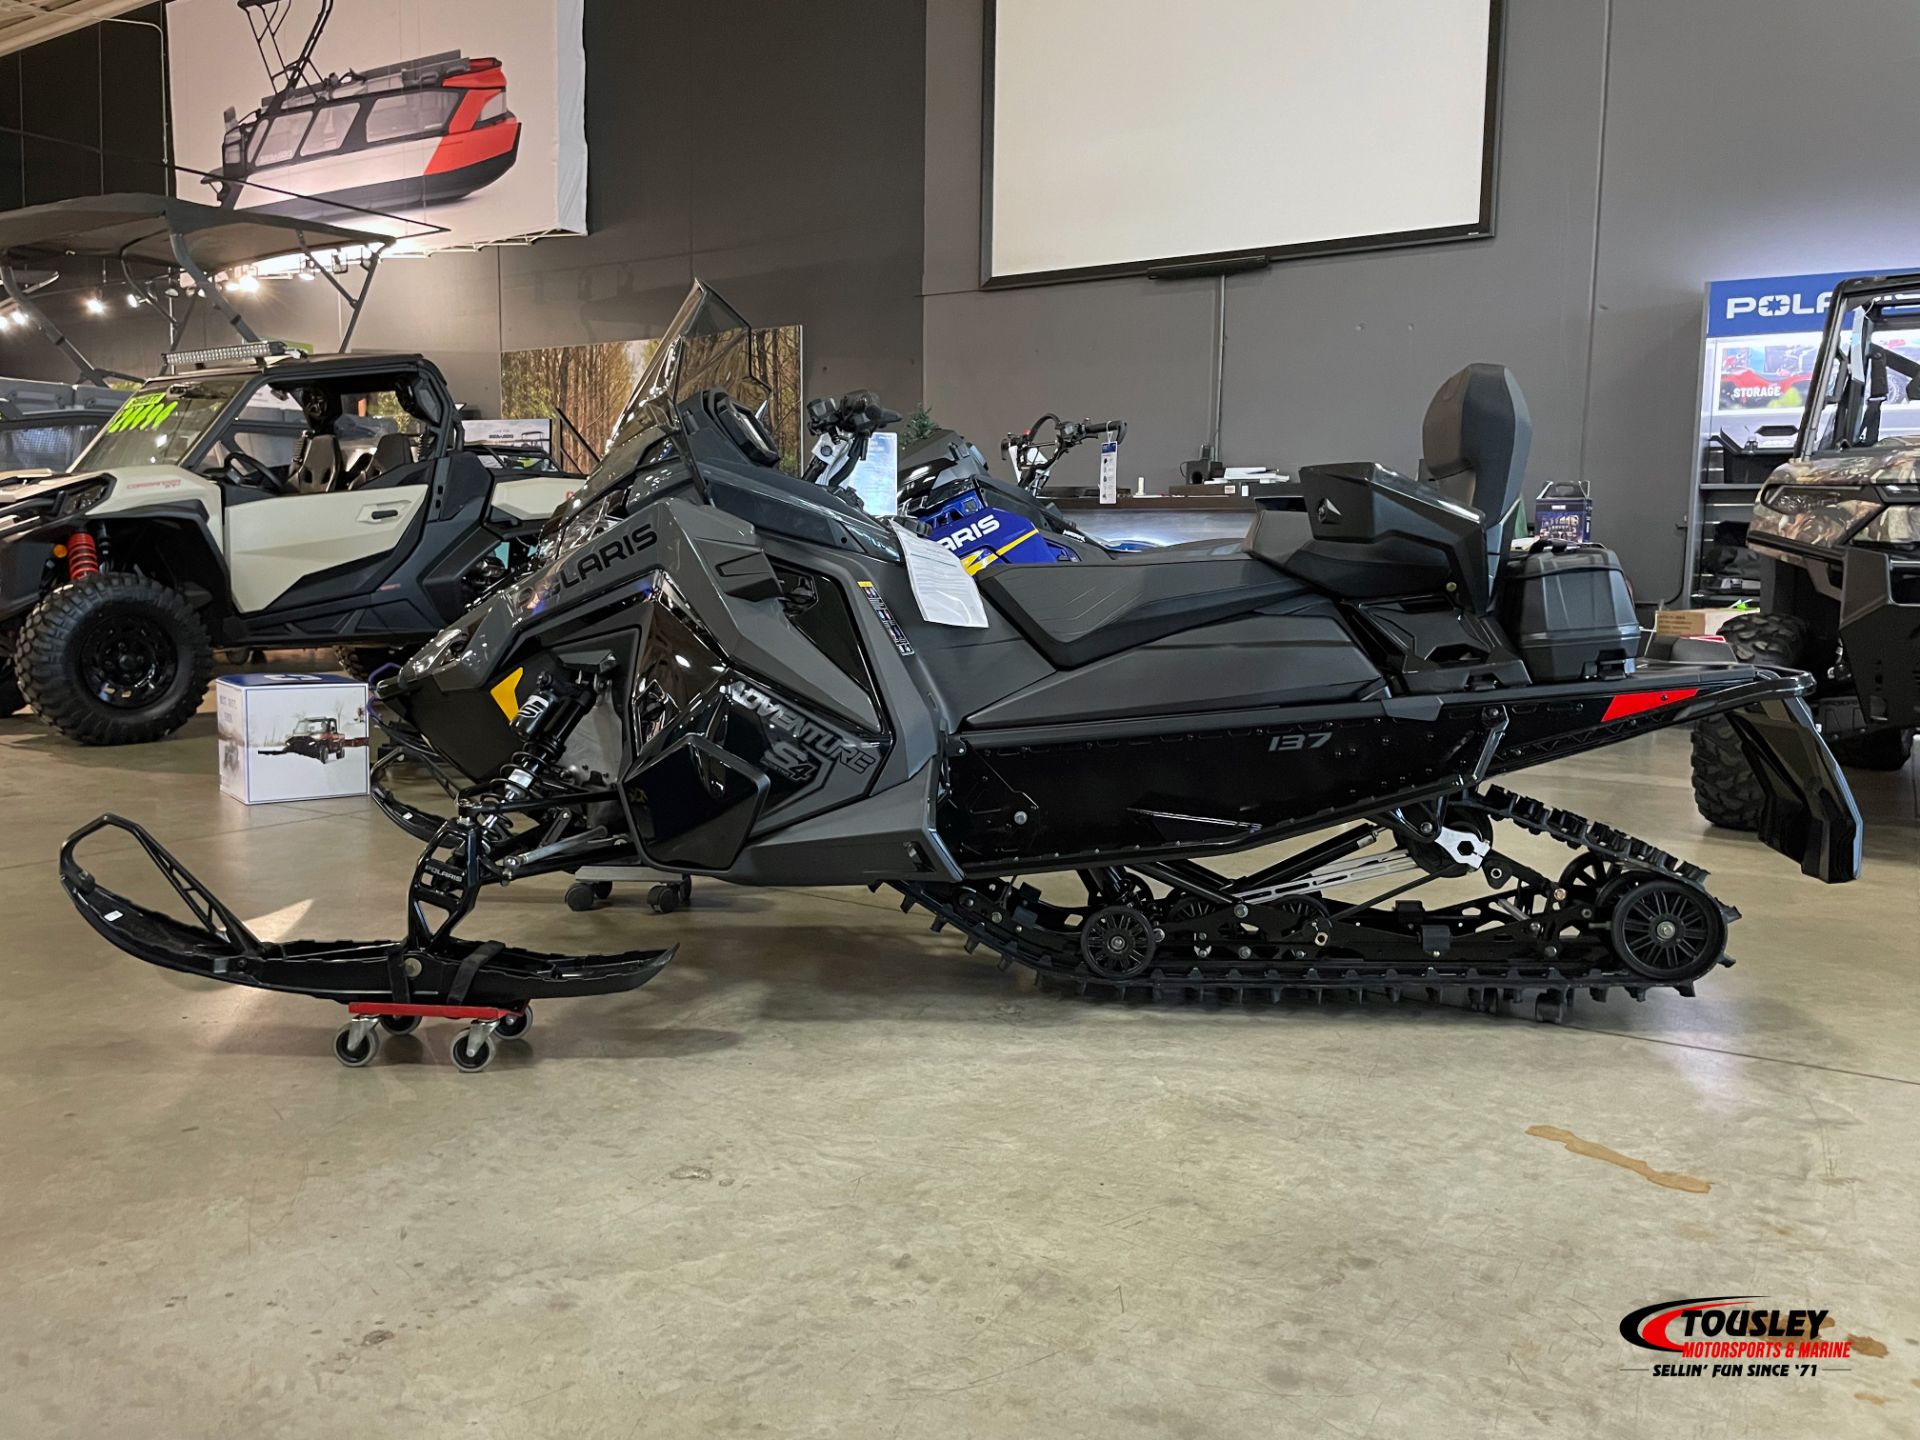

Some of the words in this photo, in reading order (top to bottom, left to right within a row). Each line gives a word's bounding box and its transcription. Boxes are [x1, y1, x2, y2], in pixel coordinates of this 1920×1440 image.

[1733, 386, 1781, 398] STORAGE
[936, 514, 1000, 551] ARIS
[728, 681, 877, 774] ADVENTURE
[1268, 732, 1333, 752] 137
[424, 864, 463, 882] POLARIS
